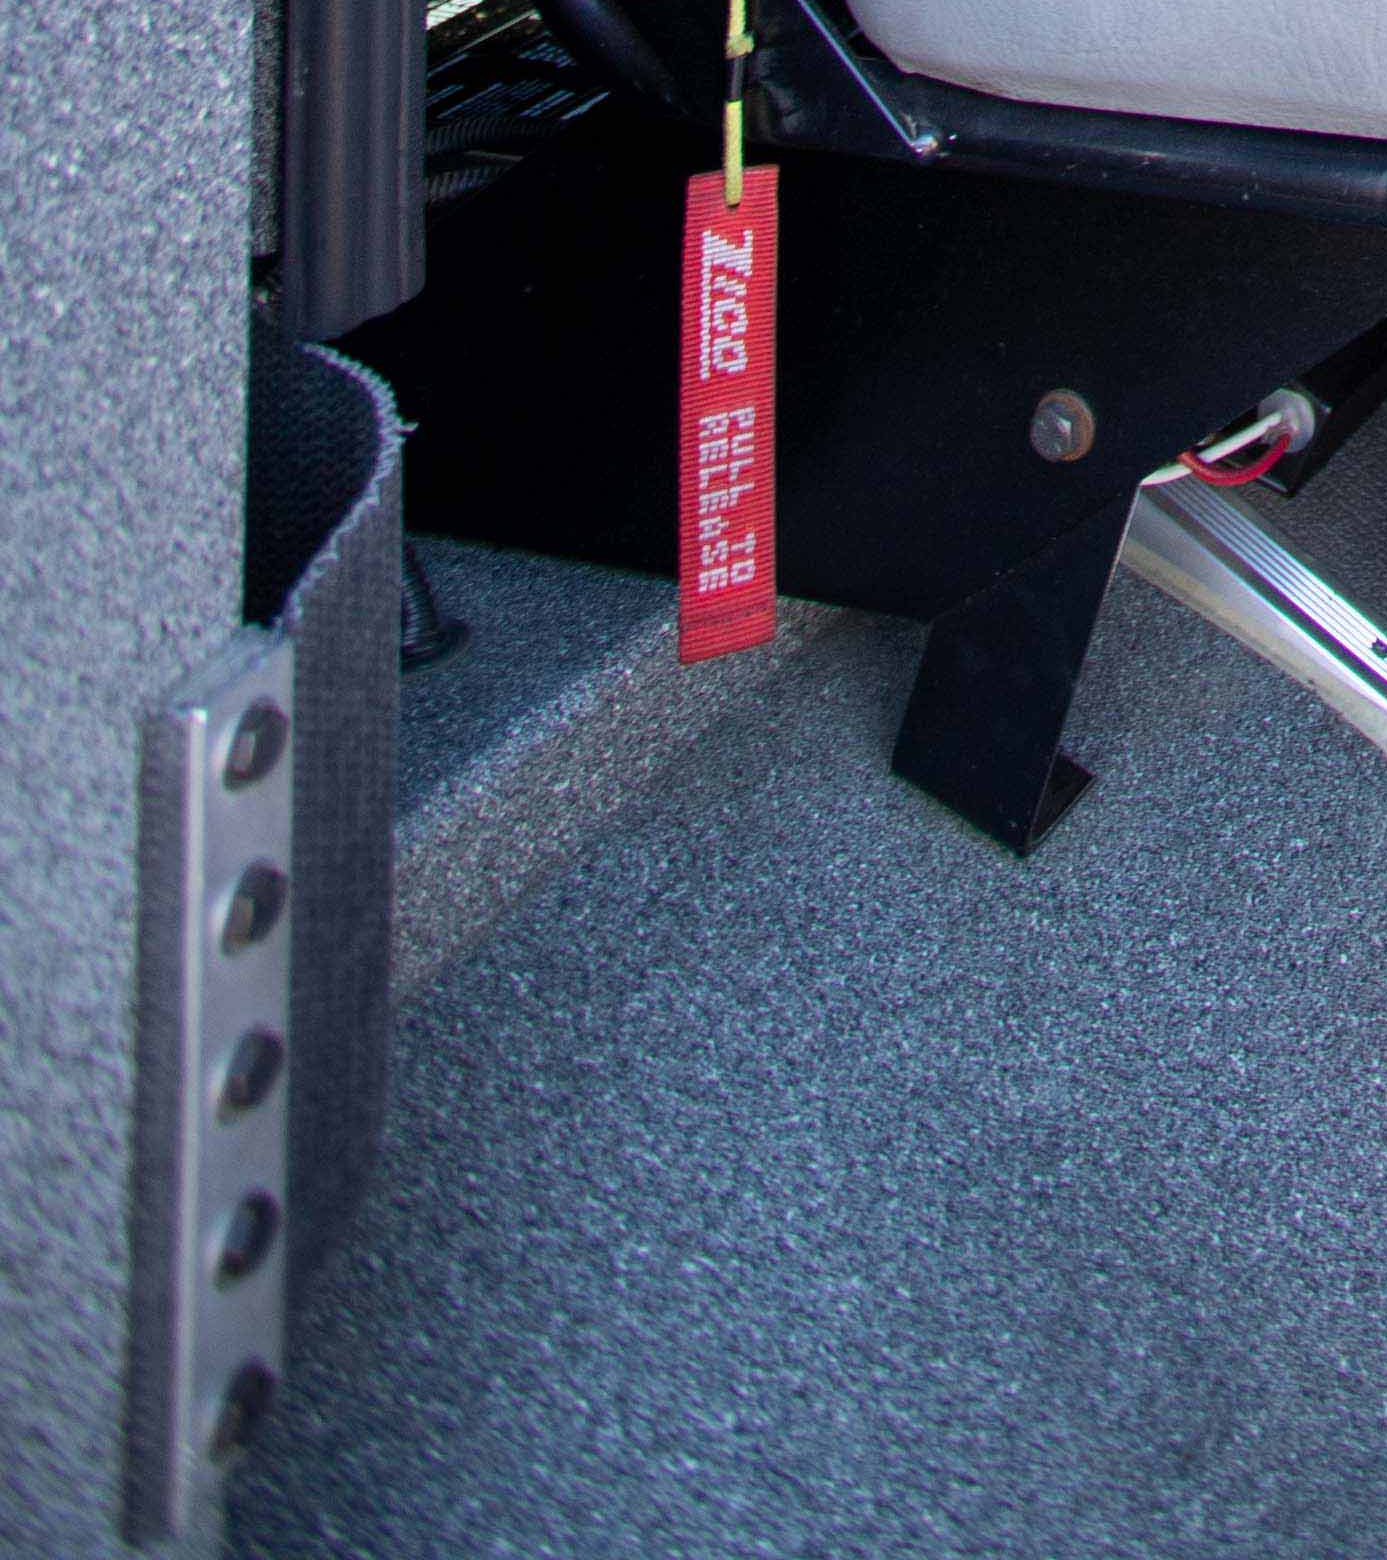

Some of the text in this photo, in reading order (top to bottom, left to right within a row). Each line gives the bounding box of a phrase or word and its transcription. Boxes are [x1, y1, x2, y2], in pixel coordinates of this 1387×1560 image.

[698, 412, 730, 592] RELEASE
[729, 406, 757, 584] PULL TO
